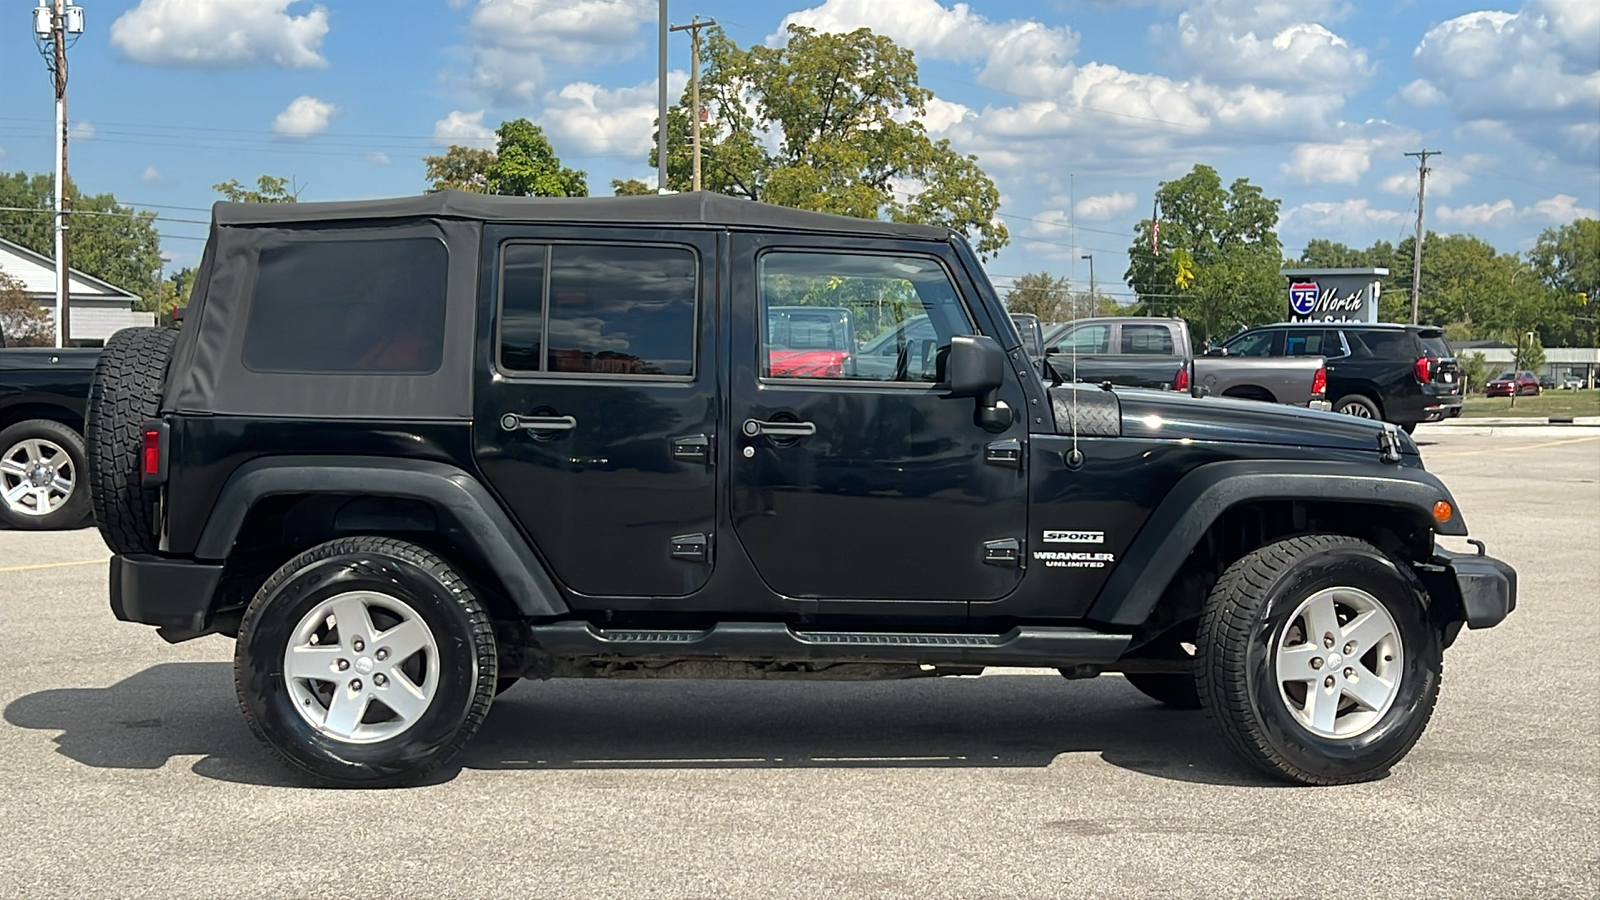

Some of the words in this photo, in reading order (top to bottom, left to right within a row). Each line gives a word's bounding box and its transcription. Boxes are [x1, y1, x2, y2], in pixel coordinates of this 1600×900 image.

[1295, 292, 1315, 307] 75
[1315, 287, 1362, 312] North
[1043, 532, 1104, 541] SPORT
[1033, 552, 1115, 562] WRANGLER
